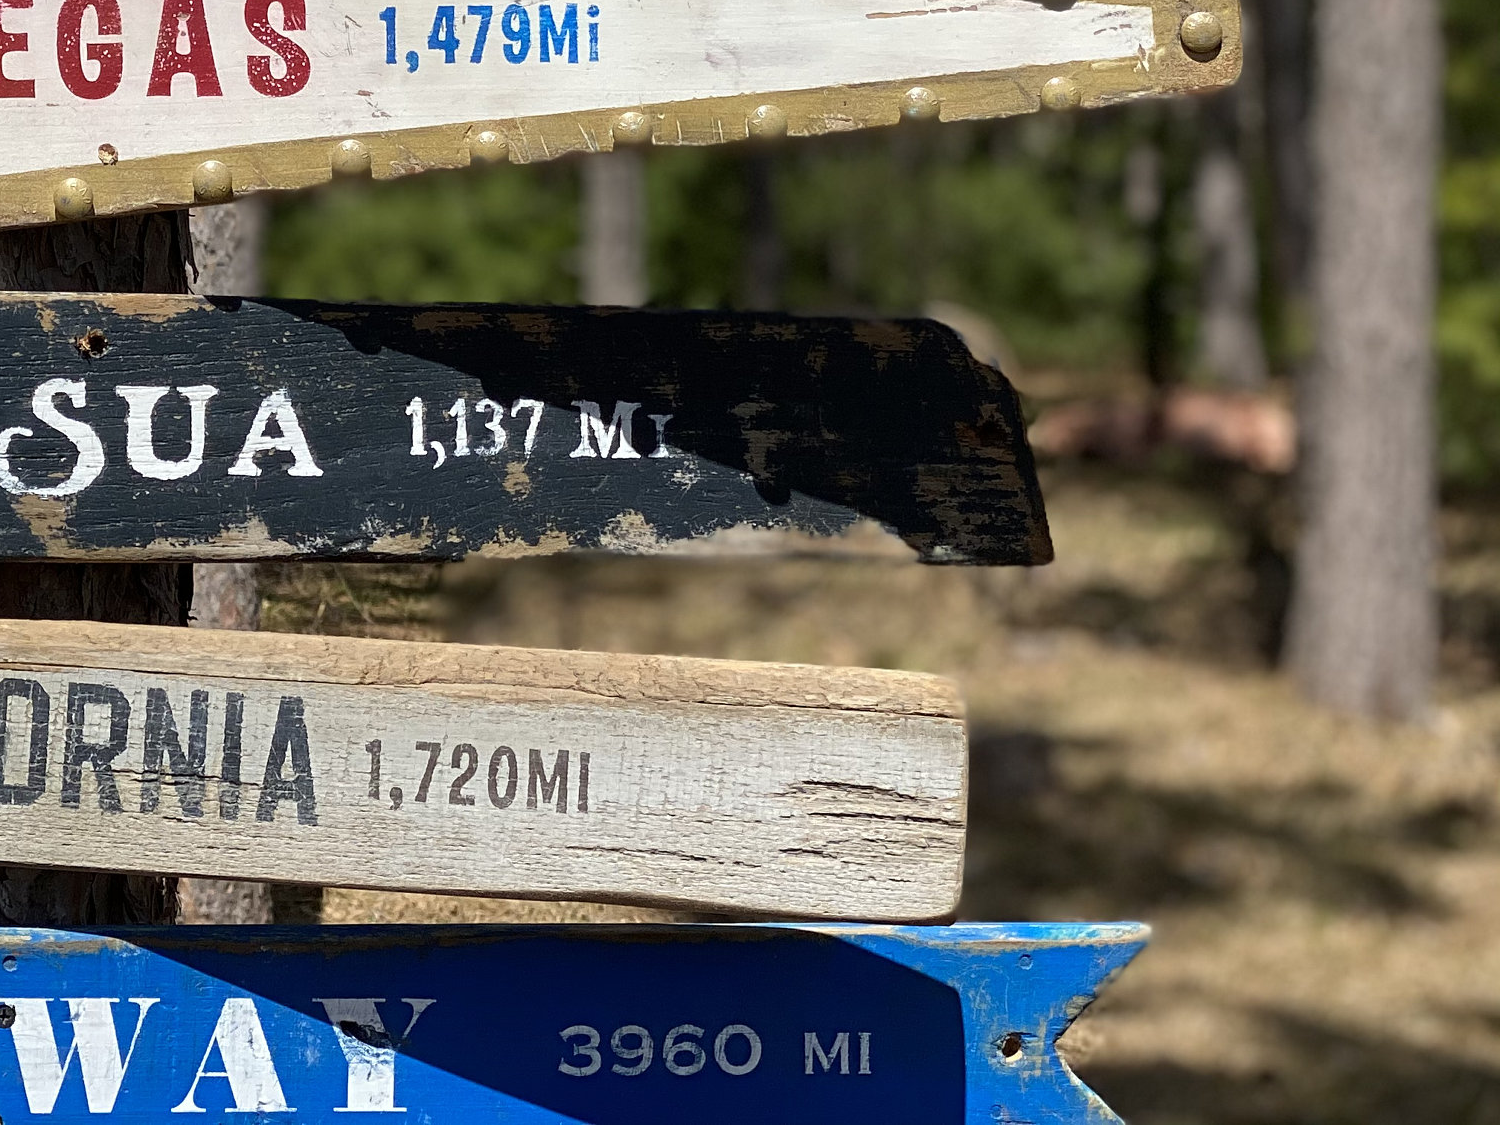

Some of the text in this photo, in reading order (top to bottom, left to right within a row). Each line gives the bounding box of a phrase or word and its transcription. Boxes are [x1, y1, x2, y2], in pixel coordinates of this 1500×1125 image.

[378, 2, 601, 75] 1,479Mi
[405, 396, 545, 470] 1,137
[365, 738, 591, 814] 1,720MI
[557, 1024, 873, 1076] 3960 MI
